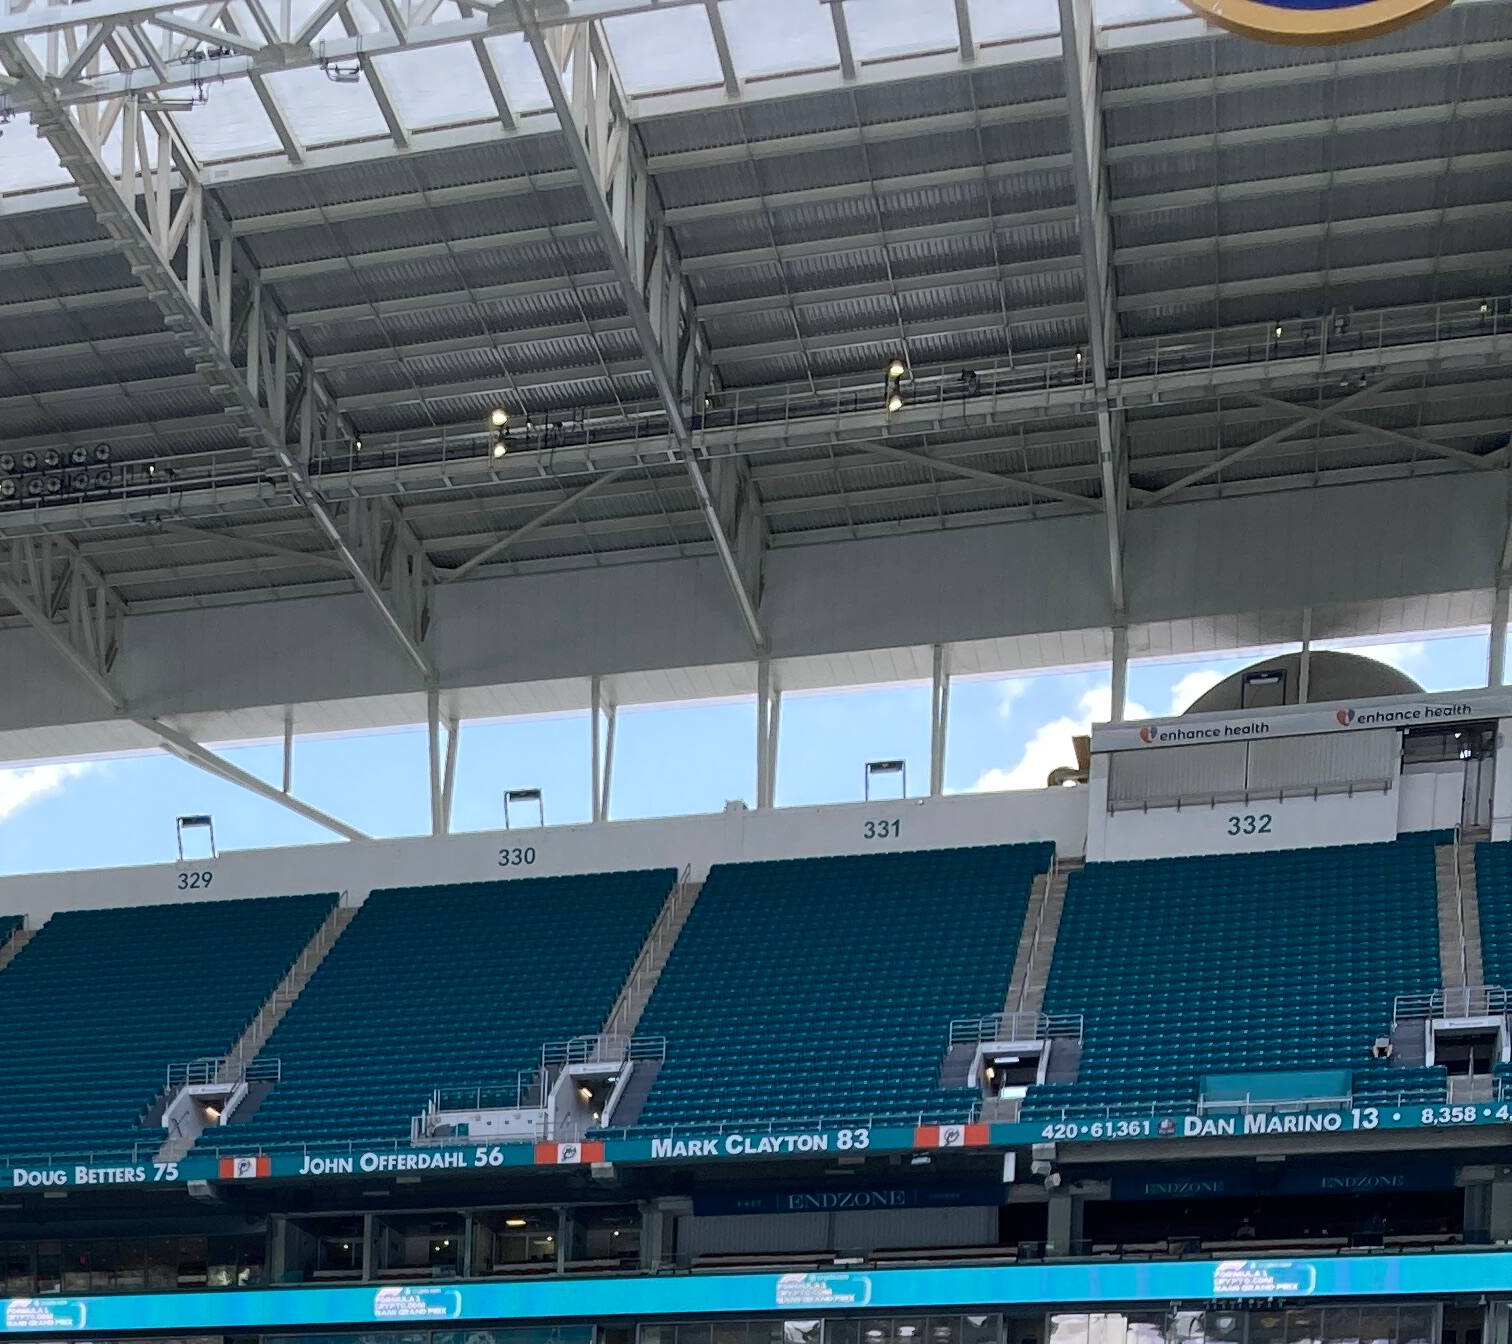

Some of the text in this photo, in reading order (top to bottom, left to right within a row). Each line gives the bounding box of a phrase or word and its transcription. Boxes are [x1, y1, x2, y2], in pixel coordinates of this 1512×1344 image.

[1357, 703, 1472, 726] enhance health
[1159, 720, 1270, 742] enhance health
[864, 819, 901, 840] 331
[1228, 814, 1273, 836] 332
[497, 847, 536, 866] 330
[178, 872, 213, 891] 329
[1184, 1114, 1236, 1137] DAN
[1243, 1111, 1343, 1135] MARINO
[1351, 1107, 1379, 1131] 13
[651, 1128, 870, 1159] MARK CLAYTON 83
[299, 1146, 504, 1176] JOHN OFFERDAHL 56
[13, 1162, 179, 1188] DOUG BETTERS 75
[788, 1189, 905, 1211] ENDZONE
